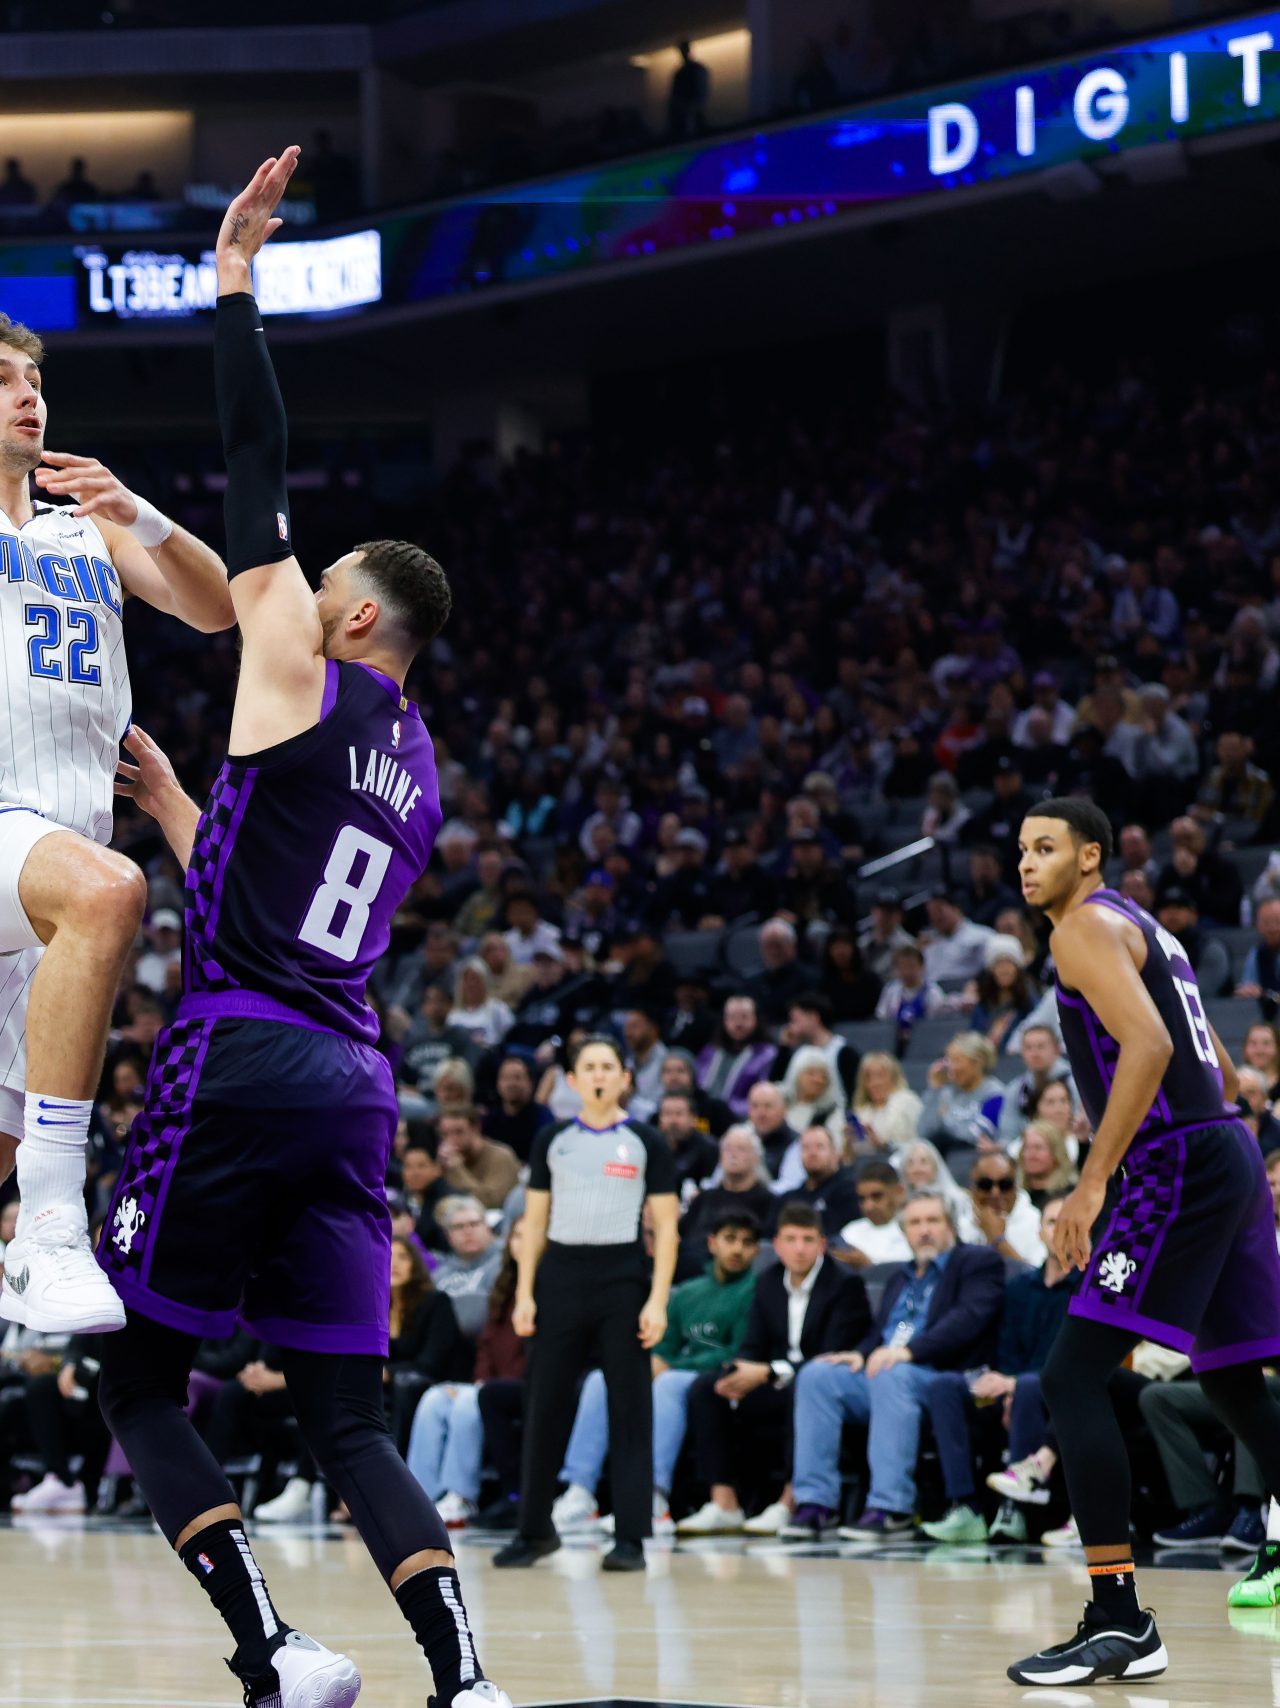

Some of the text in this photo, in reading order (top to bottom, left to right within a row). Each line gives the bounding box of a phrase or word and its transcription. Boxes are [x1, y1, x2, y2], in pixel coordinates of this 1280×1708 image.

[927, 31, 1273, 176] DIGIT
[24, 603, 102, 687] 22
[348, 746, 423, 824] LAVINE
[297, 824, 394, 963] 8
